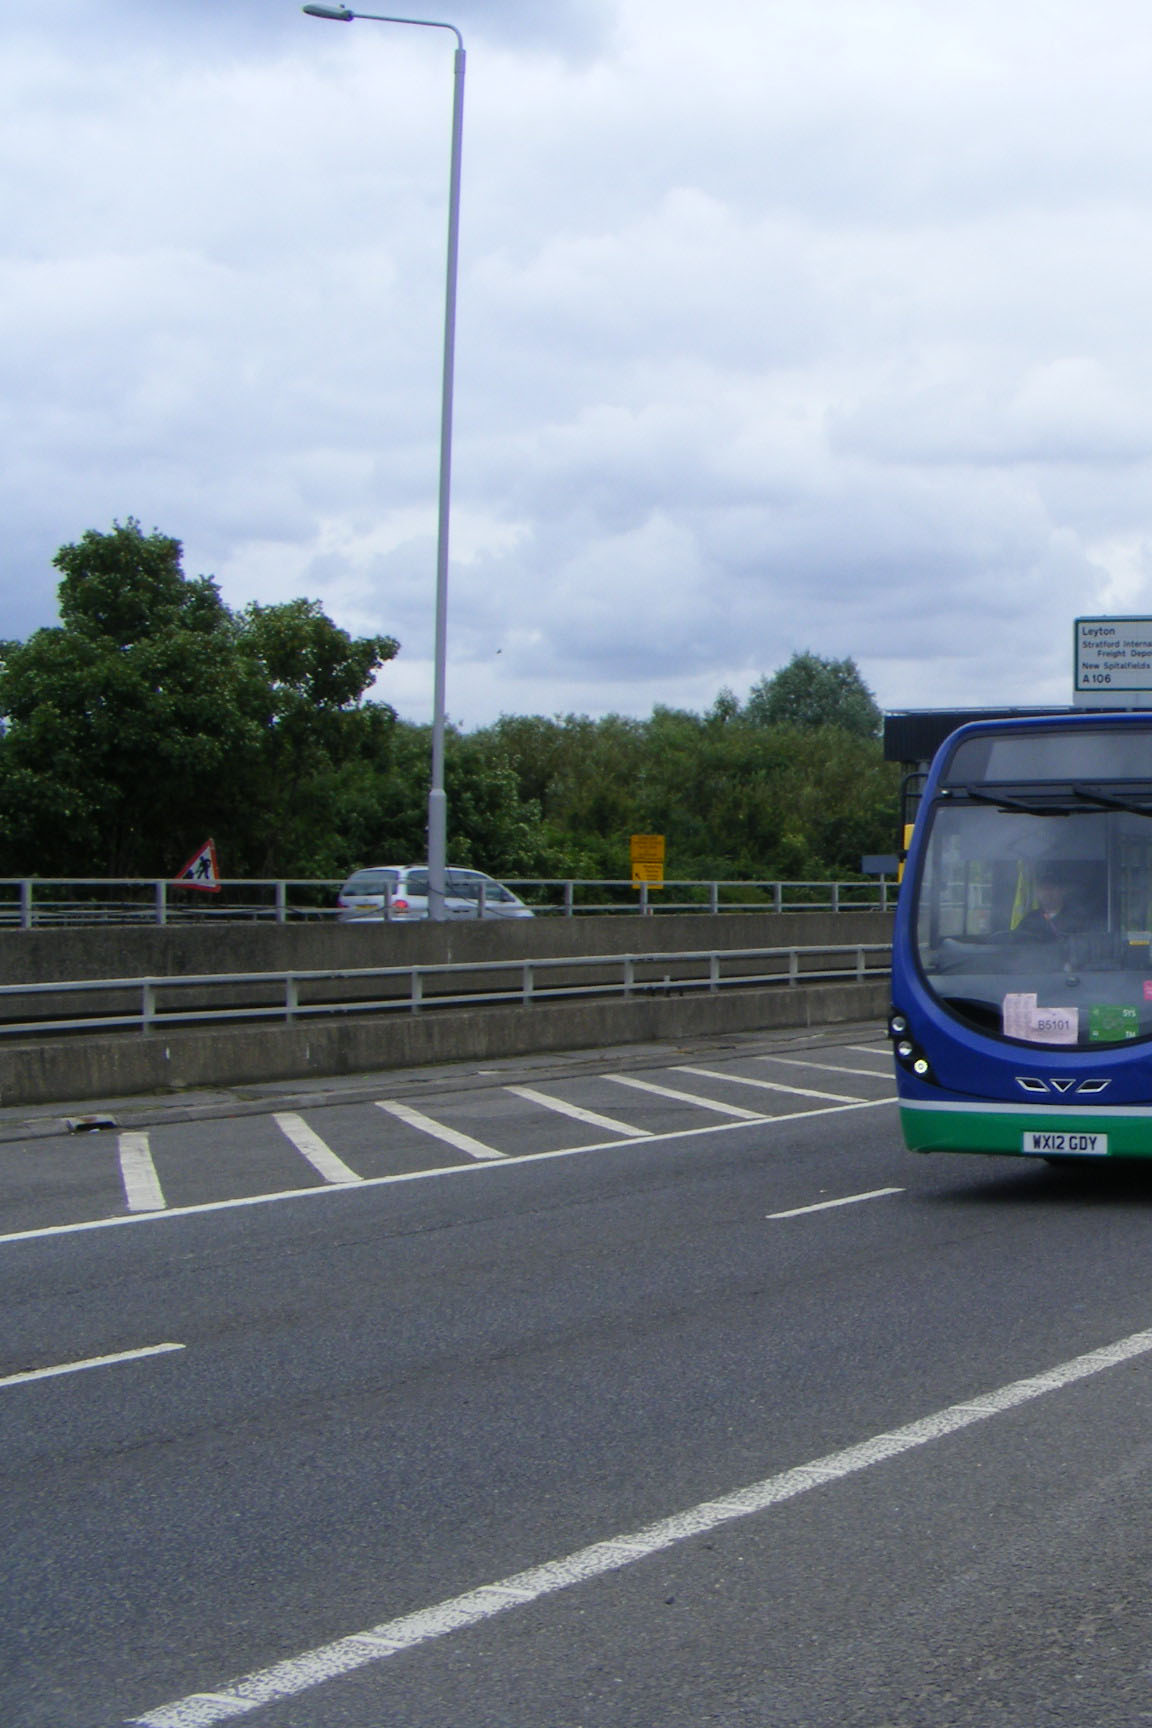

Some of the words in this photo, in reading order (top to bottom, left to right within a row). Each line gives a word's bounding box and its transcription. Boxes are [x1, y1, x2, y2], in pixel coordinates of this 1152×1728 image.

[1082, 627, 1115, 637] Leyton
[1082, 640, 1120, 648] Stratford
[1097, 650, 1126, 658] Freight
[1104, 662, 1150, 670] Spitalfields
[1038, 1020, 1070, 1031] B5101
[1032, 1134, 1065, 1150] WX12
[1069, 1135, 1097, 1151] GDY
